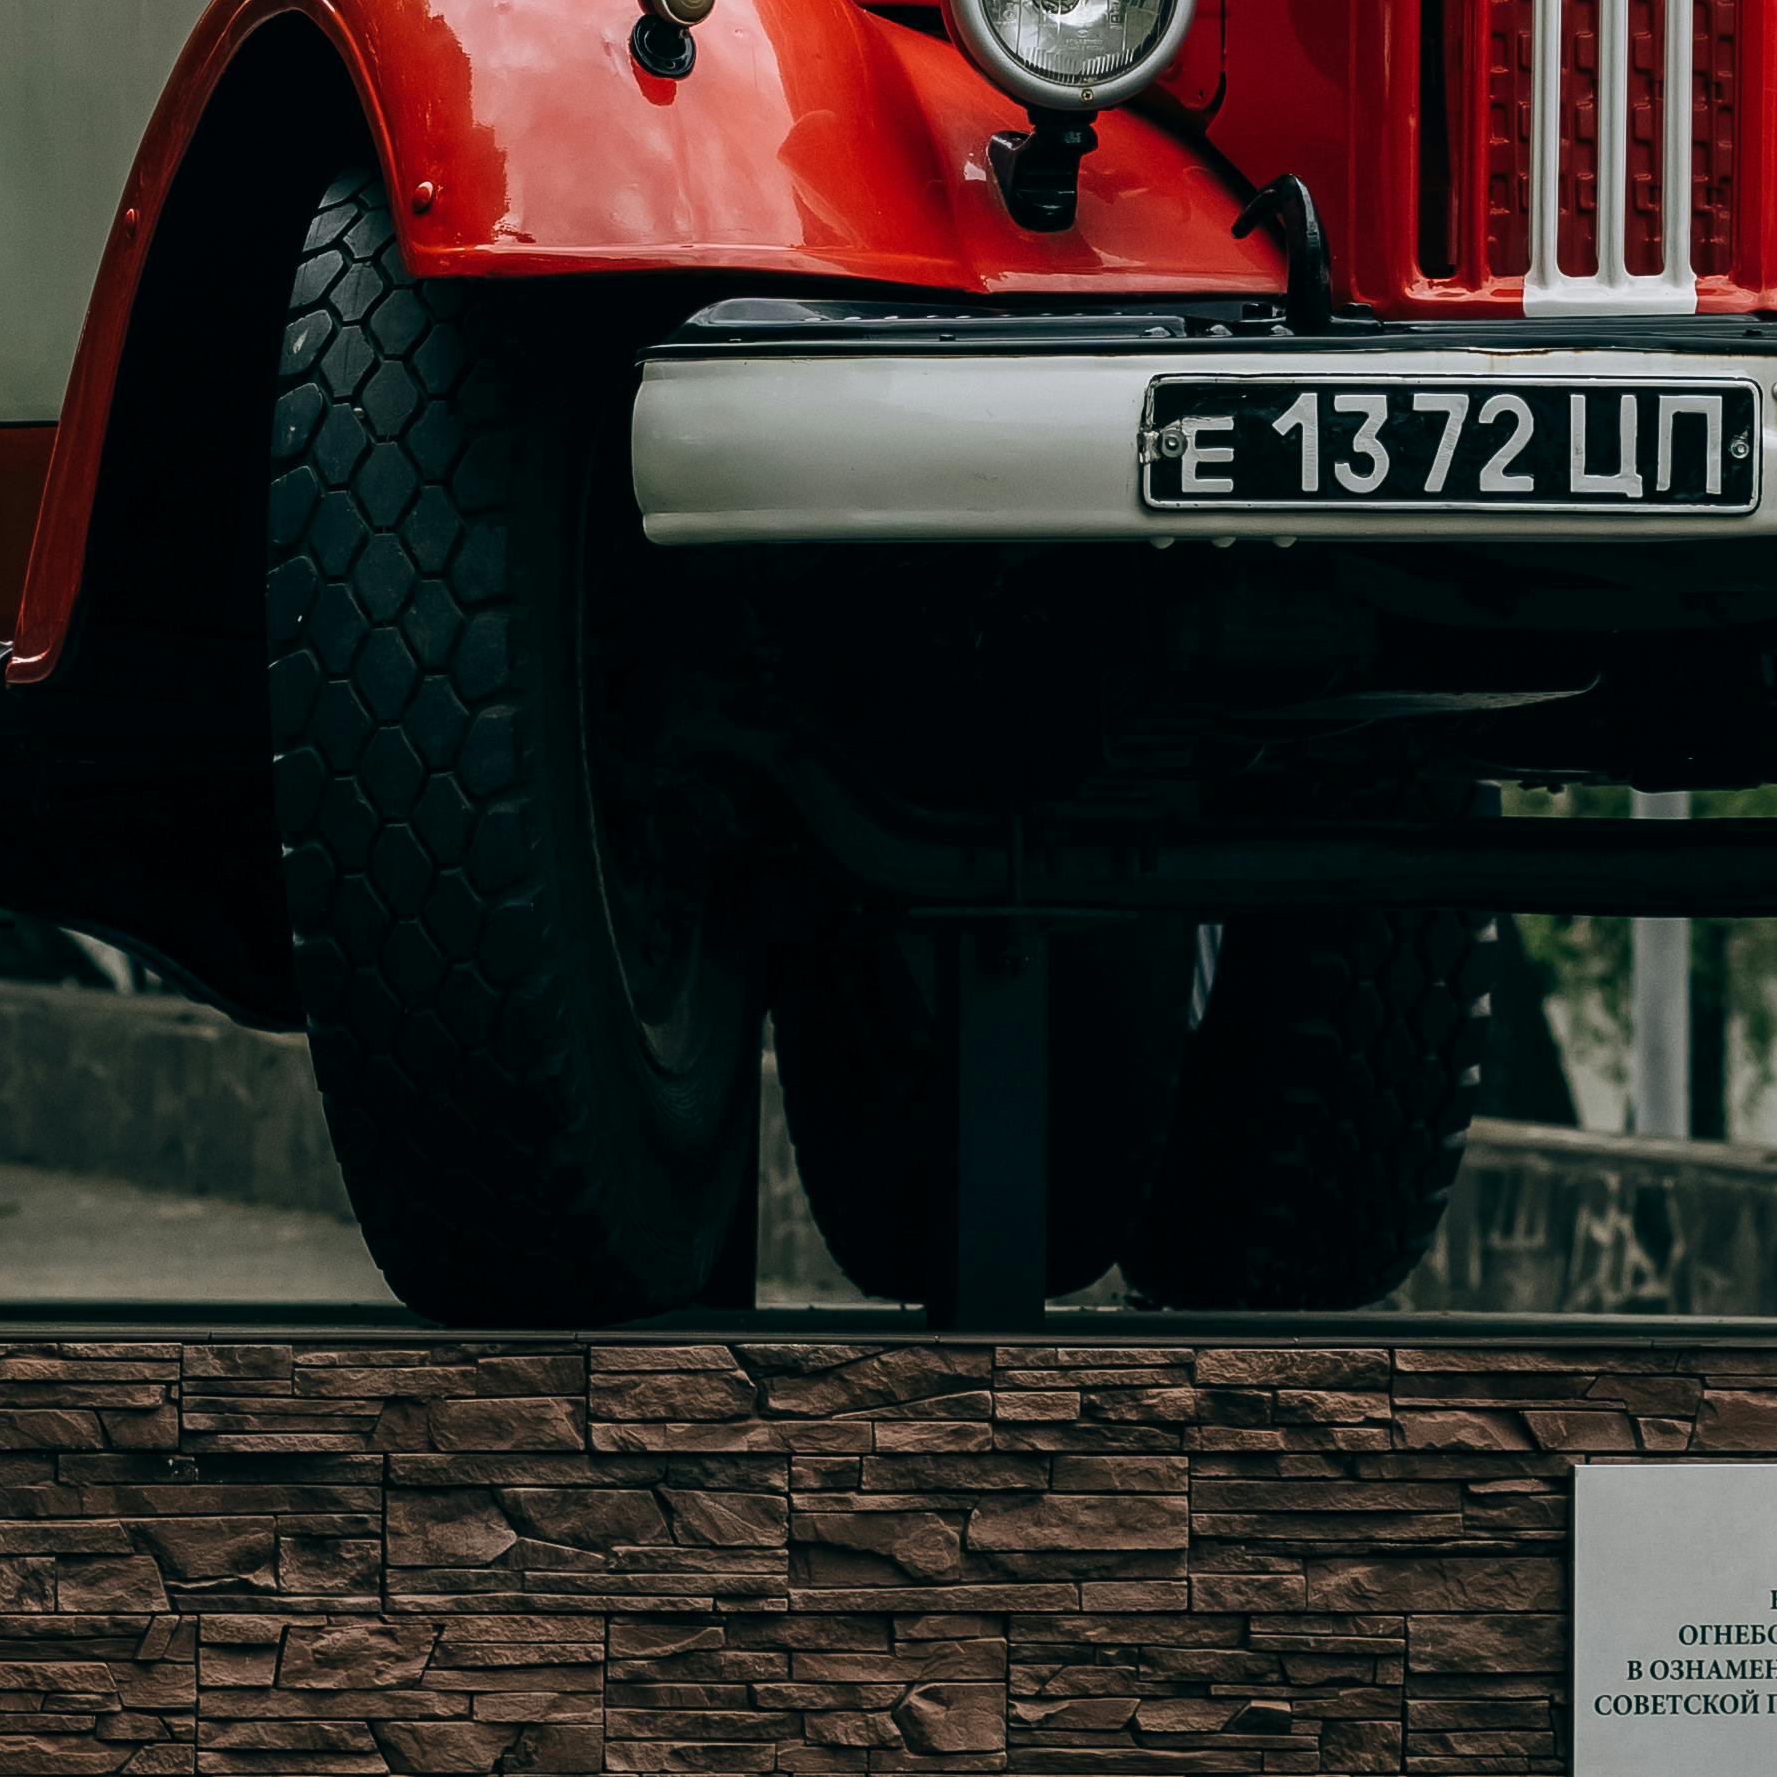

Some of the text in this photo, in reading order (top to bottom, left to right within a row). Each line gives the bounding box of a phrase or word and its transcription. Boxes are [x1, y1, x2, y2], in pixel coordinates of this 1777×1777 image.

[1270, 392, 1535, 494] 1372
[1570, 393, 1723, 499] ЦП
[1626, 1659, 1643, 1681] В
[1594, 1688, 1760, 1715] СОВЕТСКОЙ
